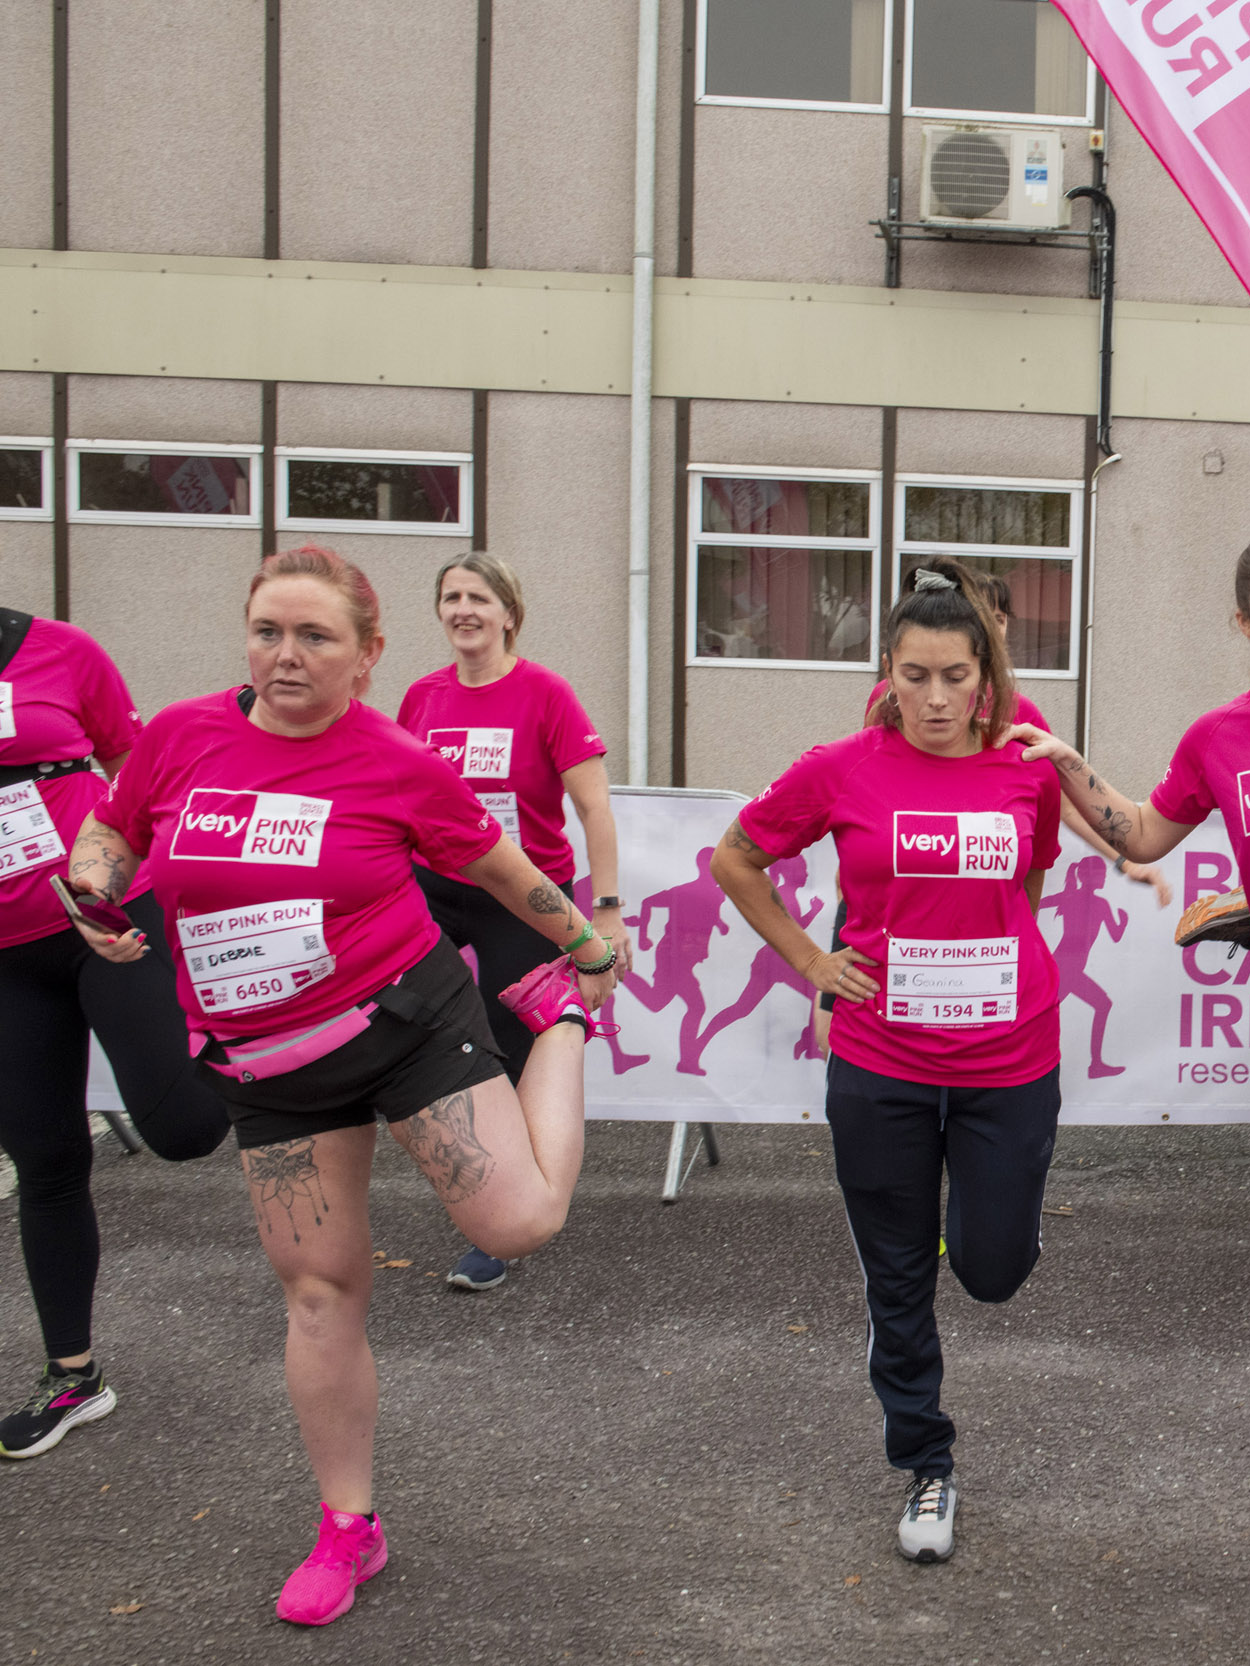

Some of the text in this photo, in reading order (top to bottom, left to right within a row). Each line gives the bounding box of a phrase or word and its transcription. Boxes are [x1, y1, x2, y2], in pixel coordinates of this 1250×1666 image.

[470, 746, 505, 758] PINK
[469, 760, 500, 772] RUN
[185, 812, 318, 838] very PINK
[250, 836, 307, 856] RUN
[900, 833, 1014, 856] very PINK
[965, 854, 1010, 871] RUN
[186, 905, 311, 939] VERY PINK RUN
[207, 945, 266, 968] DEBBIE
[899, 945, 1010, 959] VERY PINK RUN
[235, 977, 283, 1000] 6450
[932, 1004, 974, 1018] 1594
